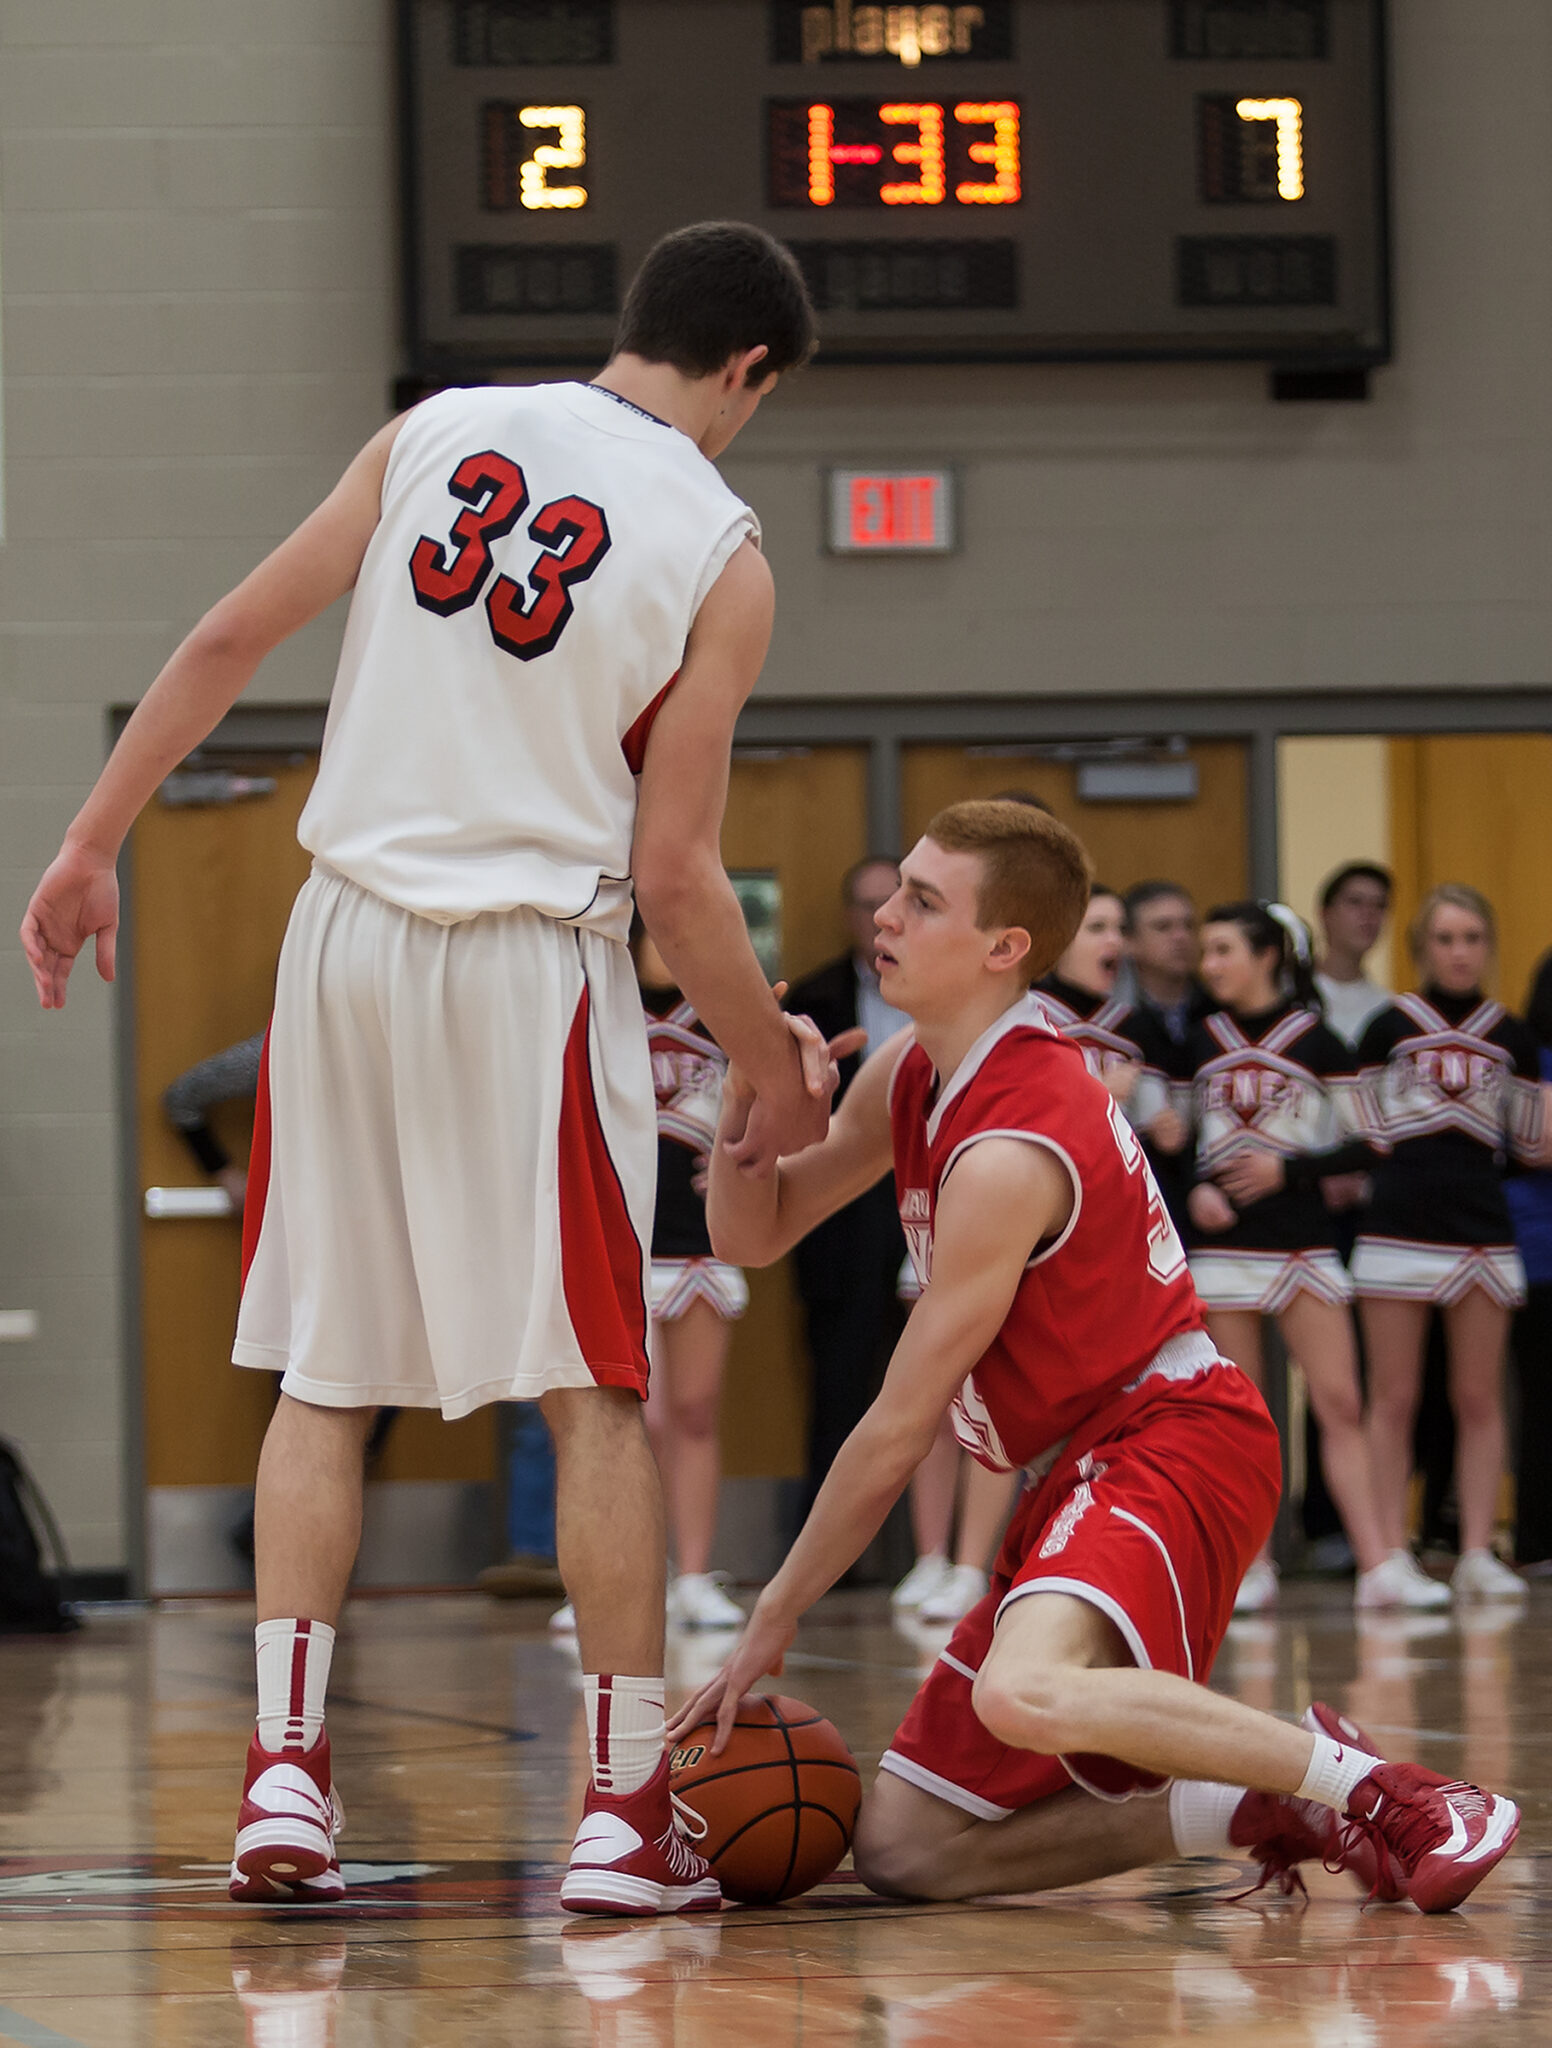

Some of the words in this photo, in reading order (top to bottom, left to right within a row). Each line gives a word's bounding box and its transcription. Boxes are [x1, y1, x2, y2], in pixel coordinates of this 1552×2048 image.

[519, 105, 588, 209] 2
[1236, 97, 1304, 200] 7
[409, 449, 612, 662] 33
[849, 476, 936, 547] EXIT
